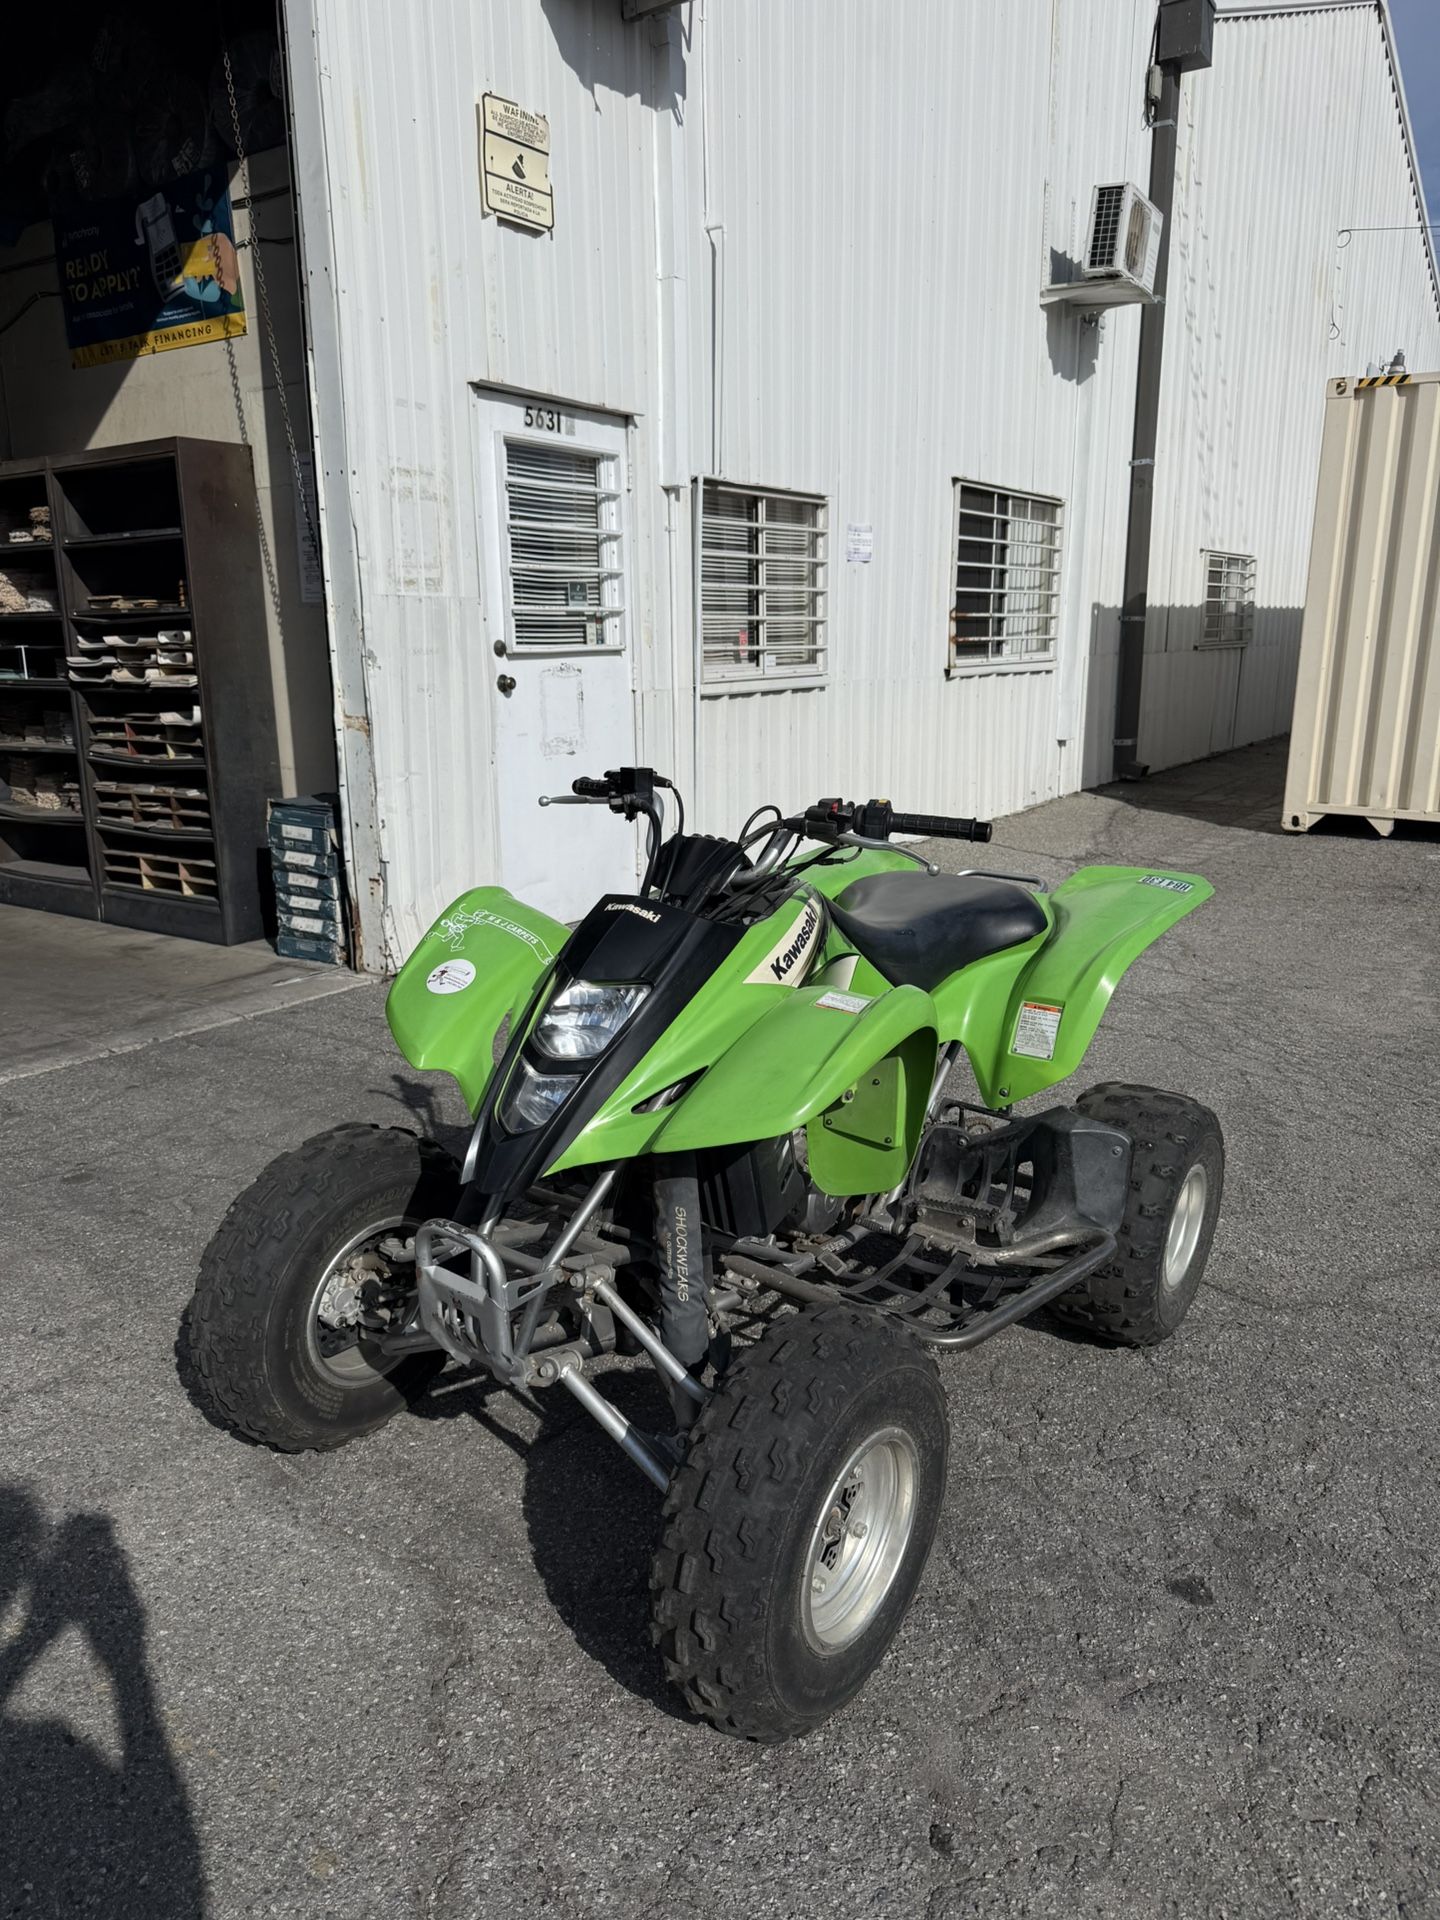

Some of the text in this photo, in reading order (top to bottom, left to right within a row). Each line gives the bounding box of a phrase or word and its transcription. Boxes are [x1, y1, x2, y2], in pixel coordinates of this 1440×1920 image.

[66, 248, 108, 279] READY
[66, 283, 88, 303] TO
[155, 325, 212, 345] FINANCING
[525, 406, 561, 433] 5631
[604, 903, 661, 923] Kawasaki
[506, 924, 539, 944] CARPETS
[770, 902, 818, 981] Kawasaki
[675, 1206, 689, 1302] SHOCKWEARS
